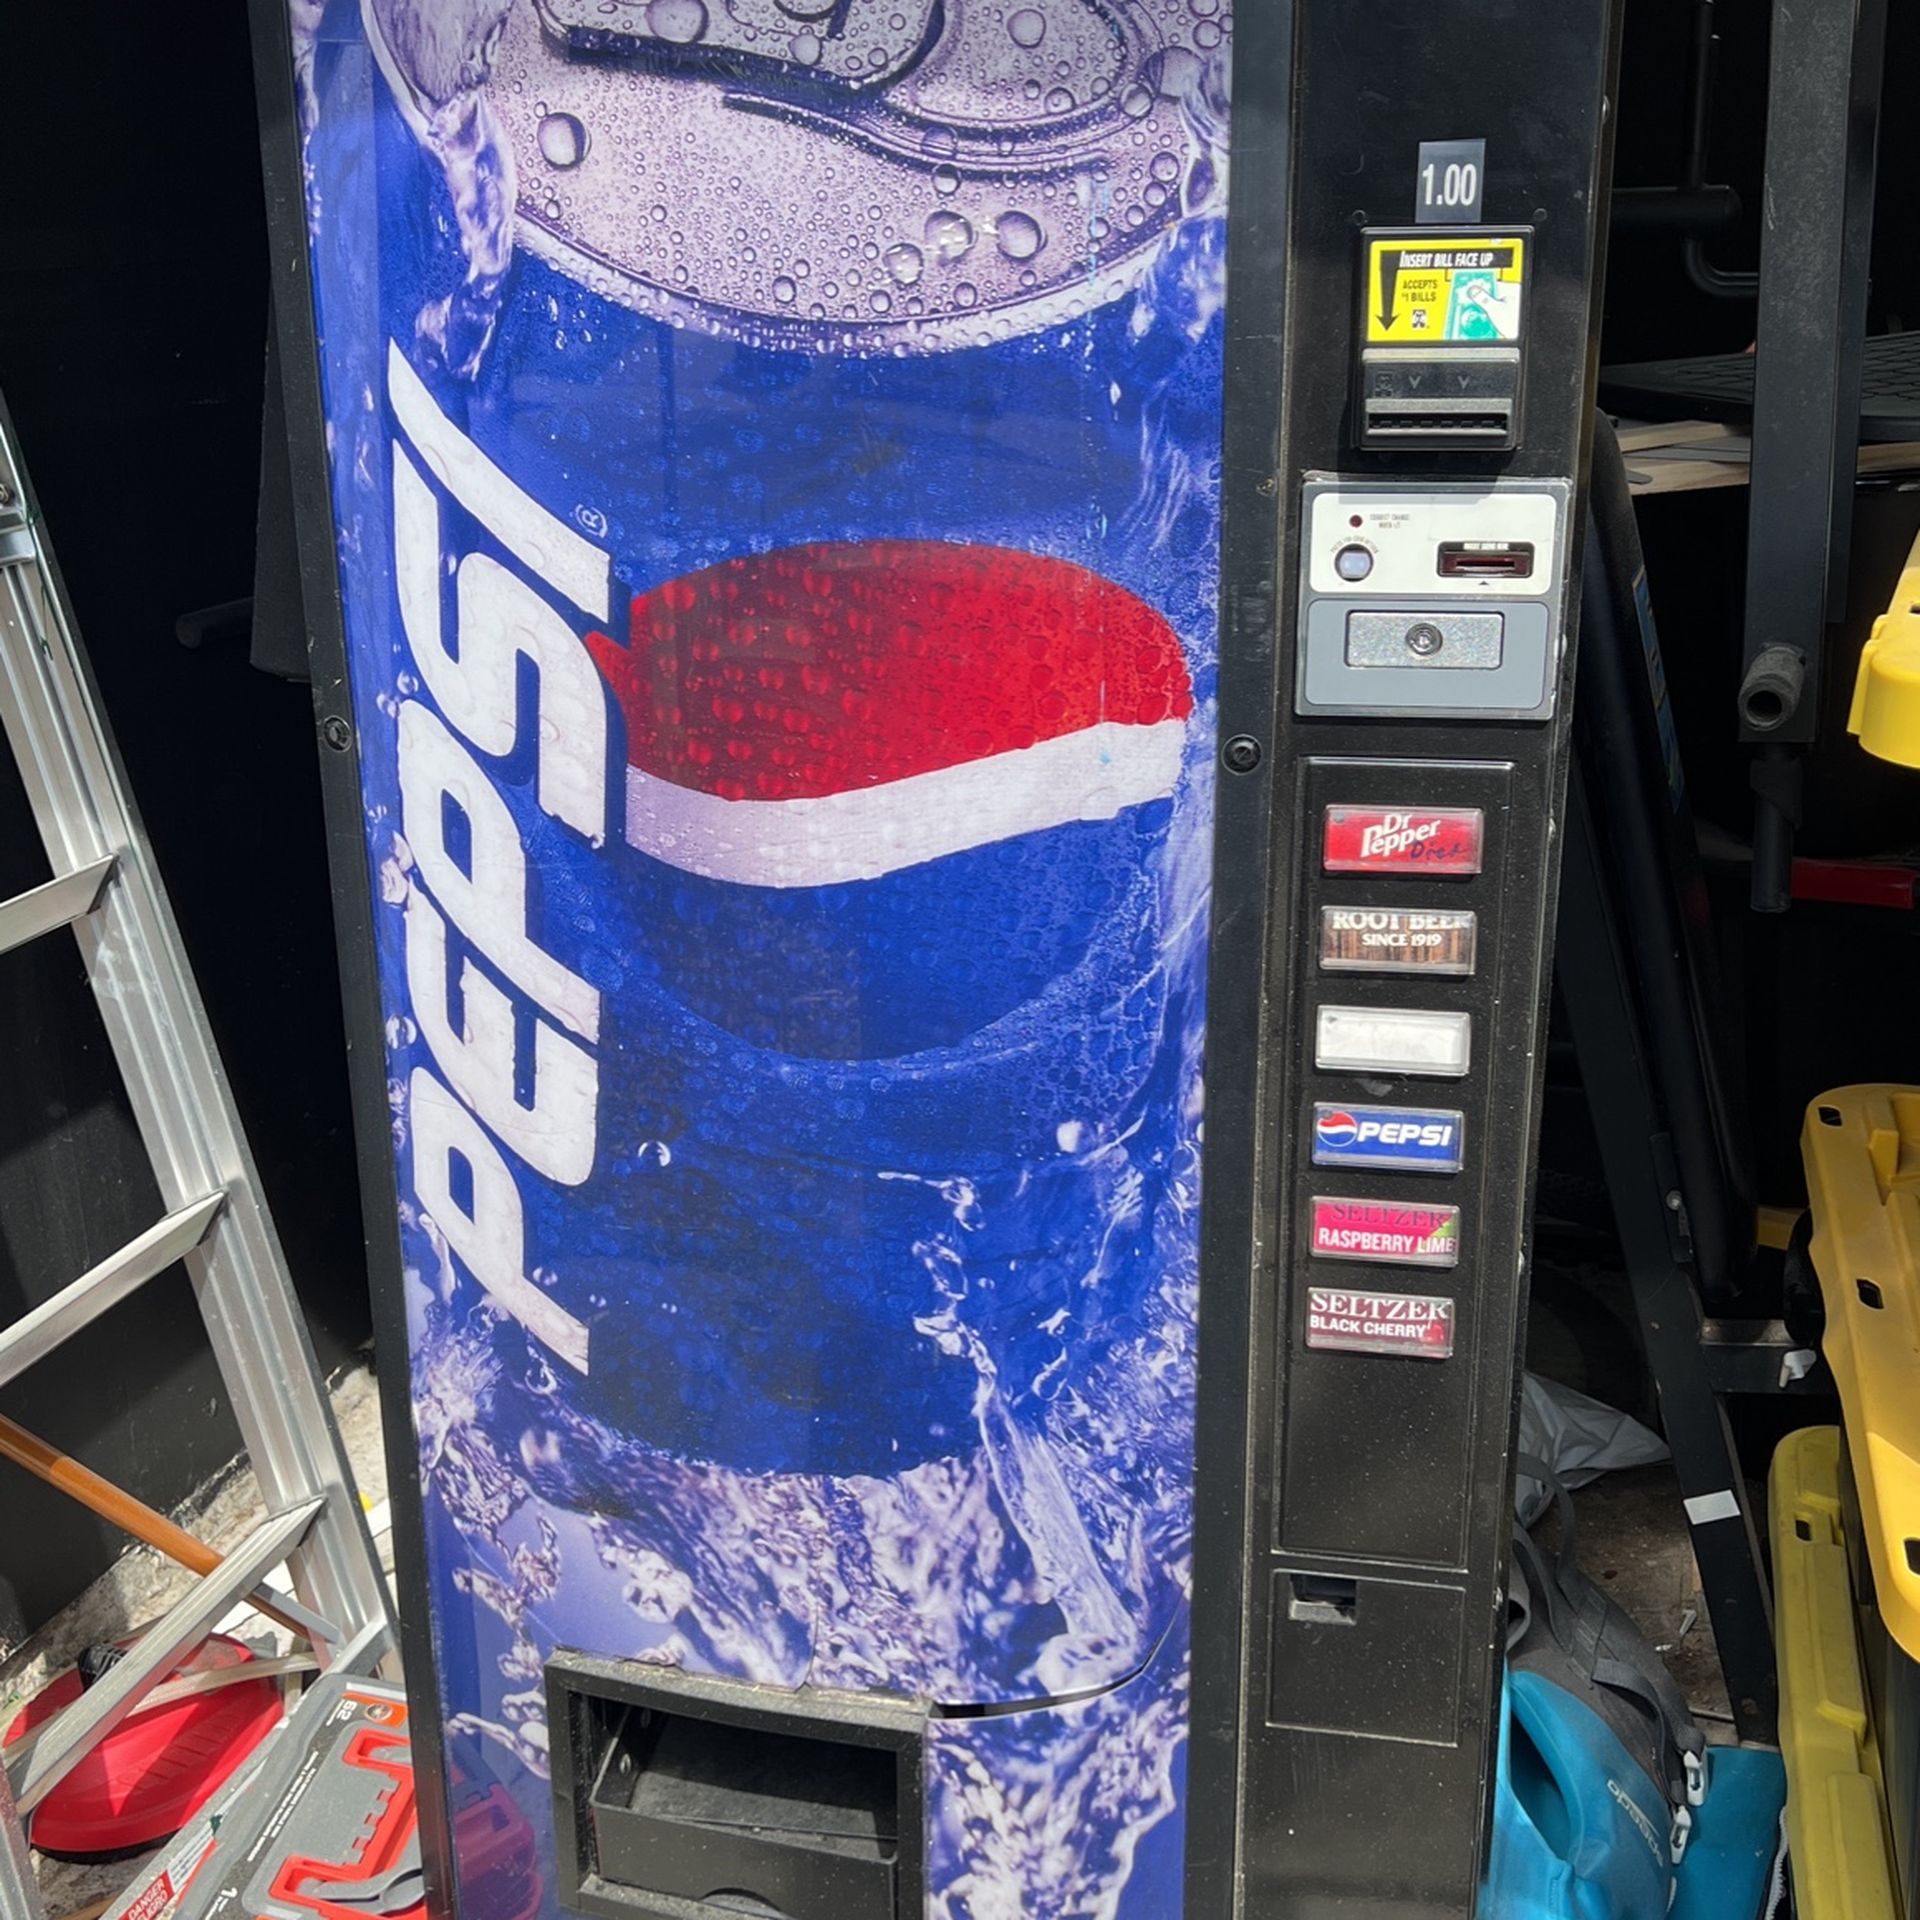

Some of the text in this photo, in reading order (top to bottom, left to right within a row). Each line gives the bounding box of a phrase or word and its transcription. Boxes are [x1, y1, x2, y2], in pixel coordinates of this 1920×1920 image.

[1422, 164, 1477, 206] 1.00
[1400, 251, 1494, 268] INSERT BILL FACE UP
[1403, 279, 1438, 290] ACCEPTS
[1411, 291, 1437, 302] BILLS
[1384, 814, 1412, 834] Dr
[1360, 820, 1441, 858] Pepper
[387, 337, 610, 1376] PEPSI
[1332, 911, 1399, 930] ROOT
[1362, 933, 1442, 946] SINCE 1919
[1357, 1121, 1453, 1146] PEPSI
[1331, 1203, 1446, 1228] SELTZER
[1319, 1227, 1457, 1253] RASPBERRY LIME
[1310, 1292, 1449, 1320] SELTZER
[1310, 1315, 1426, 1338] BLACK CHERRY
